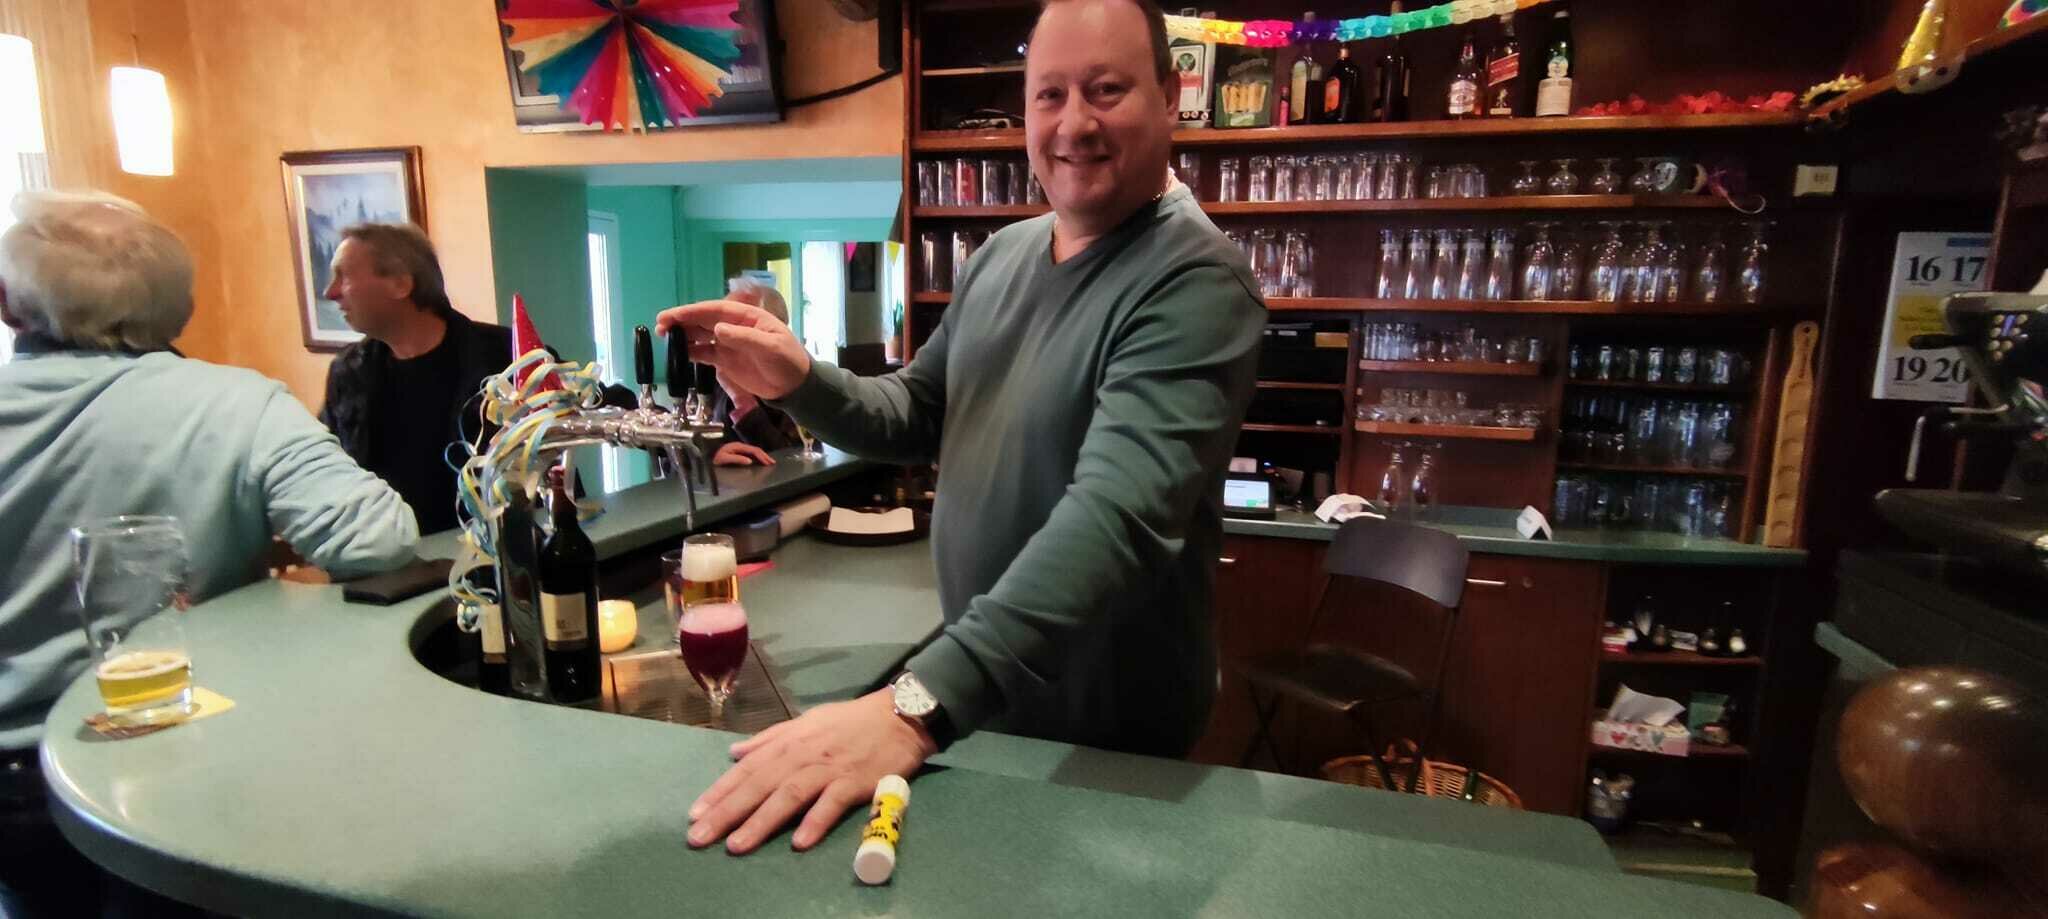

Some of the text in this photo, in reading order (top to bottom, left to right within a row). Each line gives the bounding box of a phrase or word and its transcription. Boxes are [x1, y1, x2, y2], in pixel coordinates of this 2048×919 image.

[1904, 255, 1987, 283] 16 17
[1893, 356, 1970, 385] 19 20
